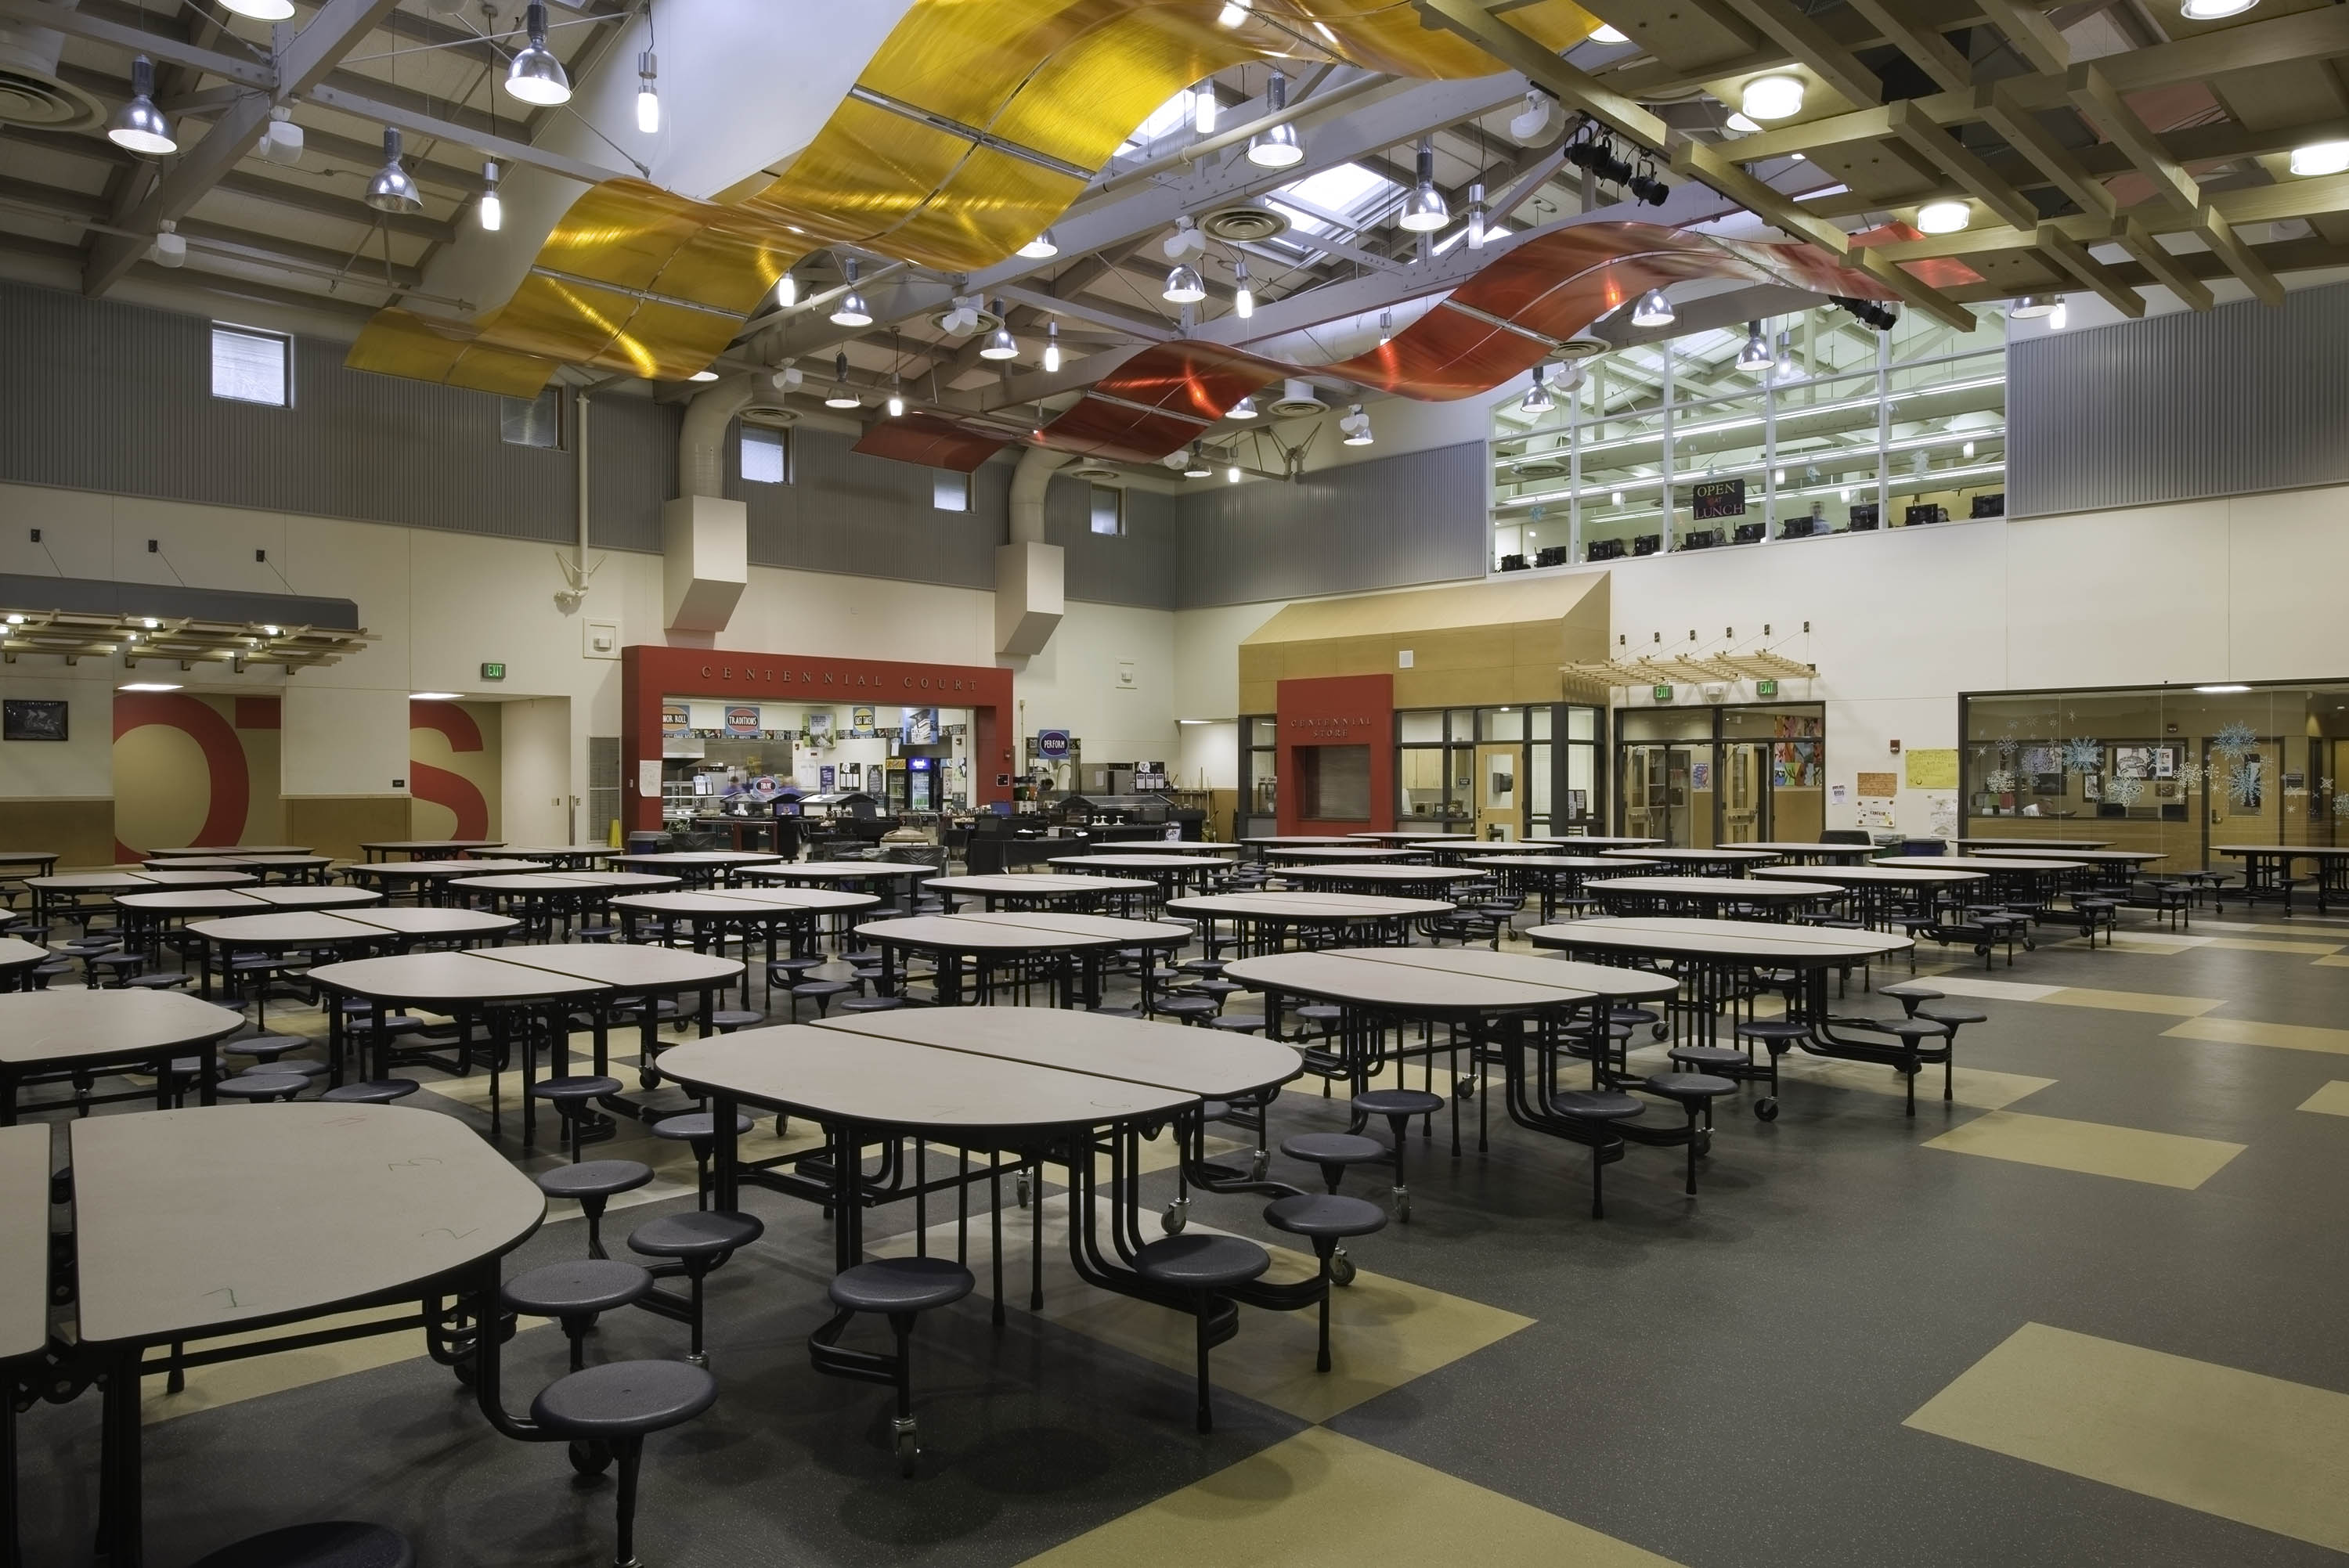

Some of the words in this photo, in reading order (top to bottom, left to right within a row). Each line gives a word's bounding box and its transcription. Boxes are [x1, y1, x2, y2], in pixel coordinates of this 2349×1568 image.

[1697, 482, 1735, 497] OPEN
[1695, 503, 1743, 519] LUNCH
[488, 665, 503, 676] EXIT
[702, 665, 882, 687] CENTENNIAL
[904, 676, 977, 690] COURT
[1656, 687, 1669, 697] EXIT
[1760, 683, 1773, 694] EXIT
[662, 715, 673, 723] NOR
[674, 715, 687, 723] ROLL
[728, 716, 756, 726] TRADITIONS
[1290, 718, 1371, 727] CENTENNIAL
[1313, 729, 1348, 738] STORE
[1044, 740, 1065, 748] PERFORM
